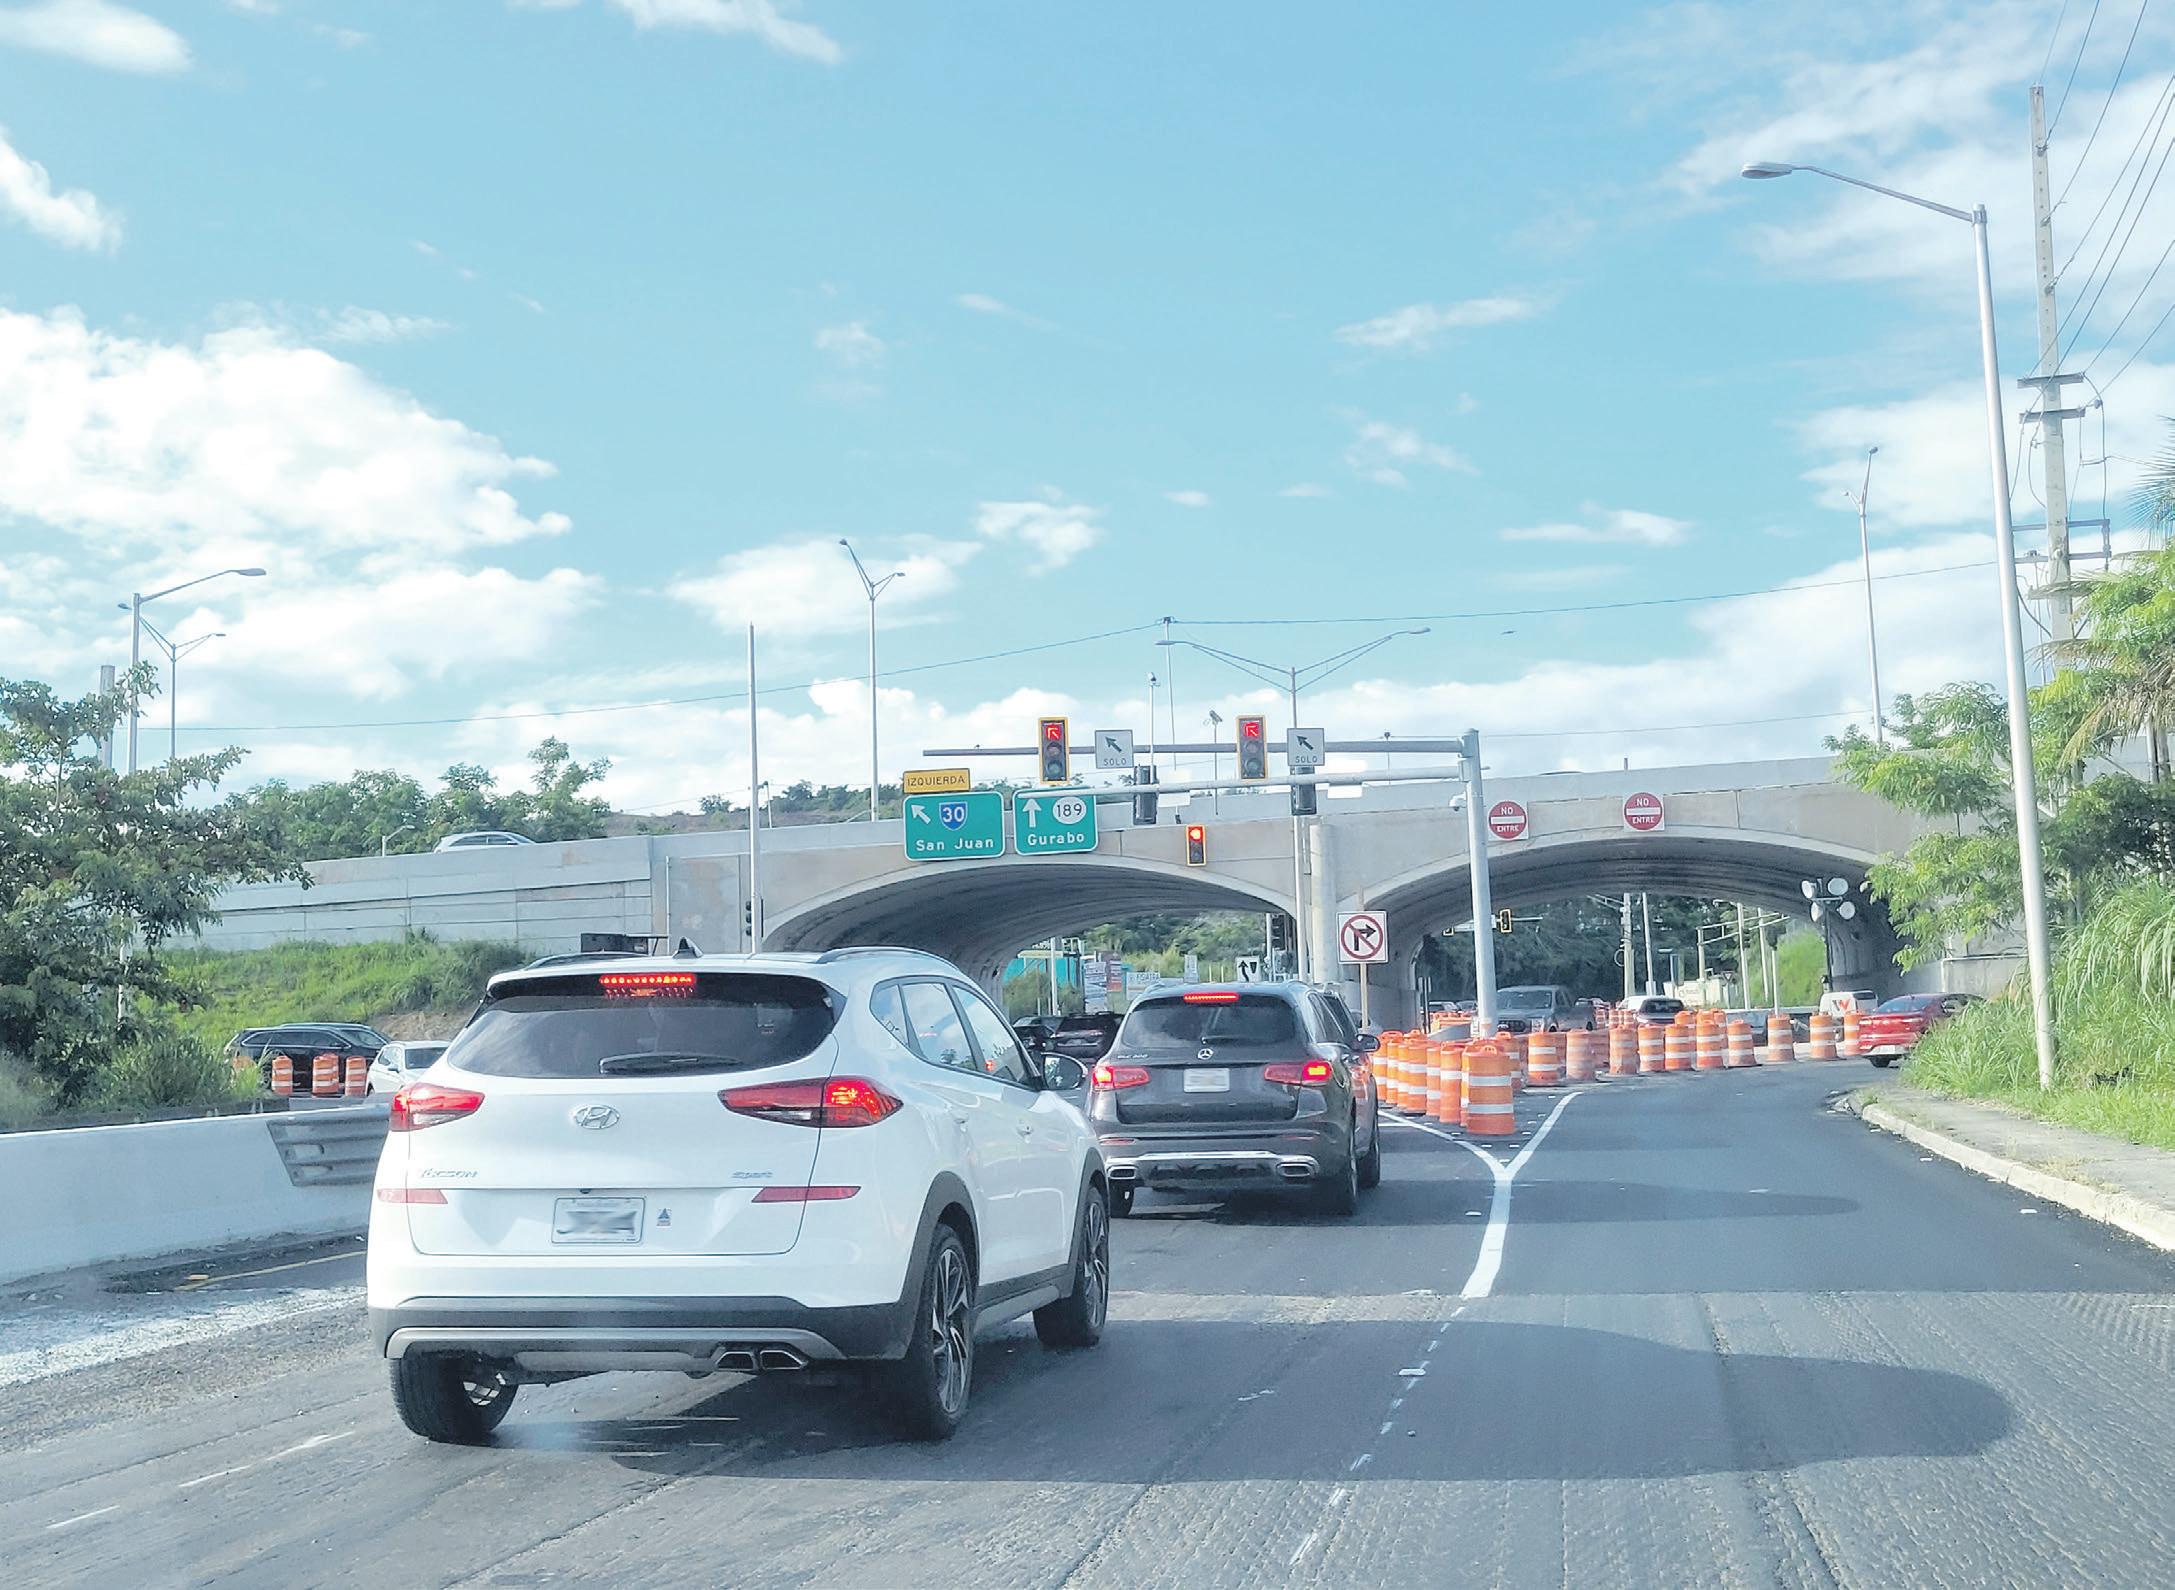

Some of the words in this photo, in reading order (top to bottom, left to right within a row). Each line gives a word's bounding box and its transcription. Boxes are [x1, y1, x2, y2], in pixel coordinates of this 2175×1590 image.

[1103, 757, 1127, 766] SOLO
[1295, 755, 1318, 764] SOLO
[907, 775, 965, 787] IZQUIERDA
[1636, 797, 1649, 807] NO
[942, 806, 965, 823] 30
[1056, 803, 1082, 818] 189
[1501, 806, 1514, 816] NO
[1632, 816, 1655, 824] ENTRE
[1496, 825, 1520, 833] ENTRE
[1027, 831, 1085, 846] Gurabo
[916, 839, 945, 852] San
[954, 837, 994, 850] Juan
